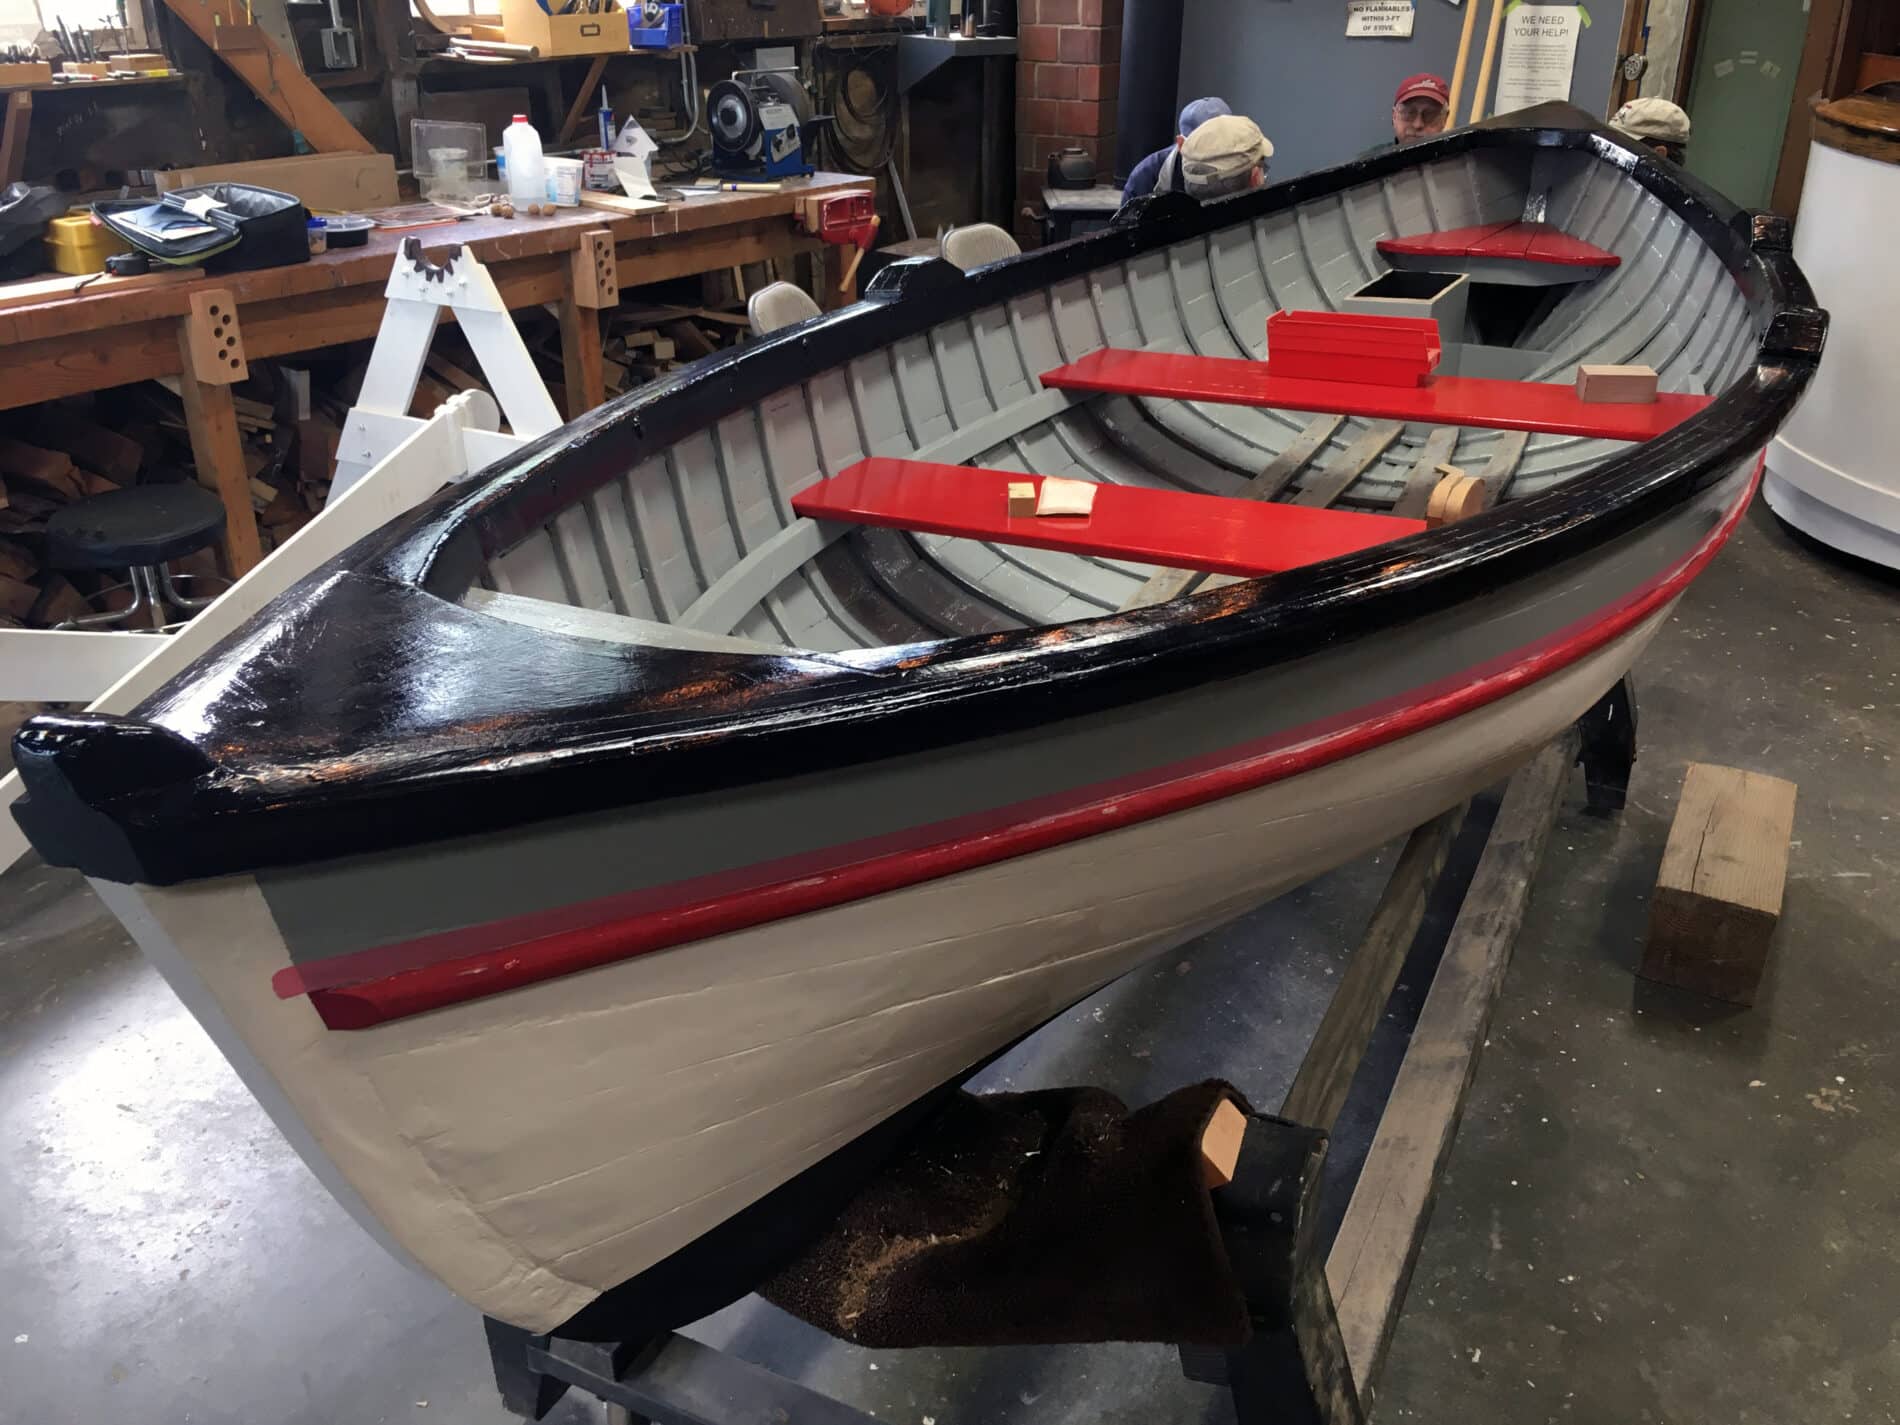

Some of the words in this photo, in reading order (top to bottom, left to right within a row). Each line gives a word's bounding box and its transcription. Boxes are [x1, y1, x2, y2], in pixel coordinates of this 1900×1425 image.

[1522, 15, 1536, 25] WE
[1538, 15, 1564, 25] NEED
[1514, 27, 1539, 36] YOUR
[1542, 28, 1568, 37] HELP!
